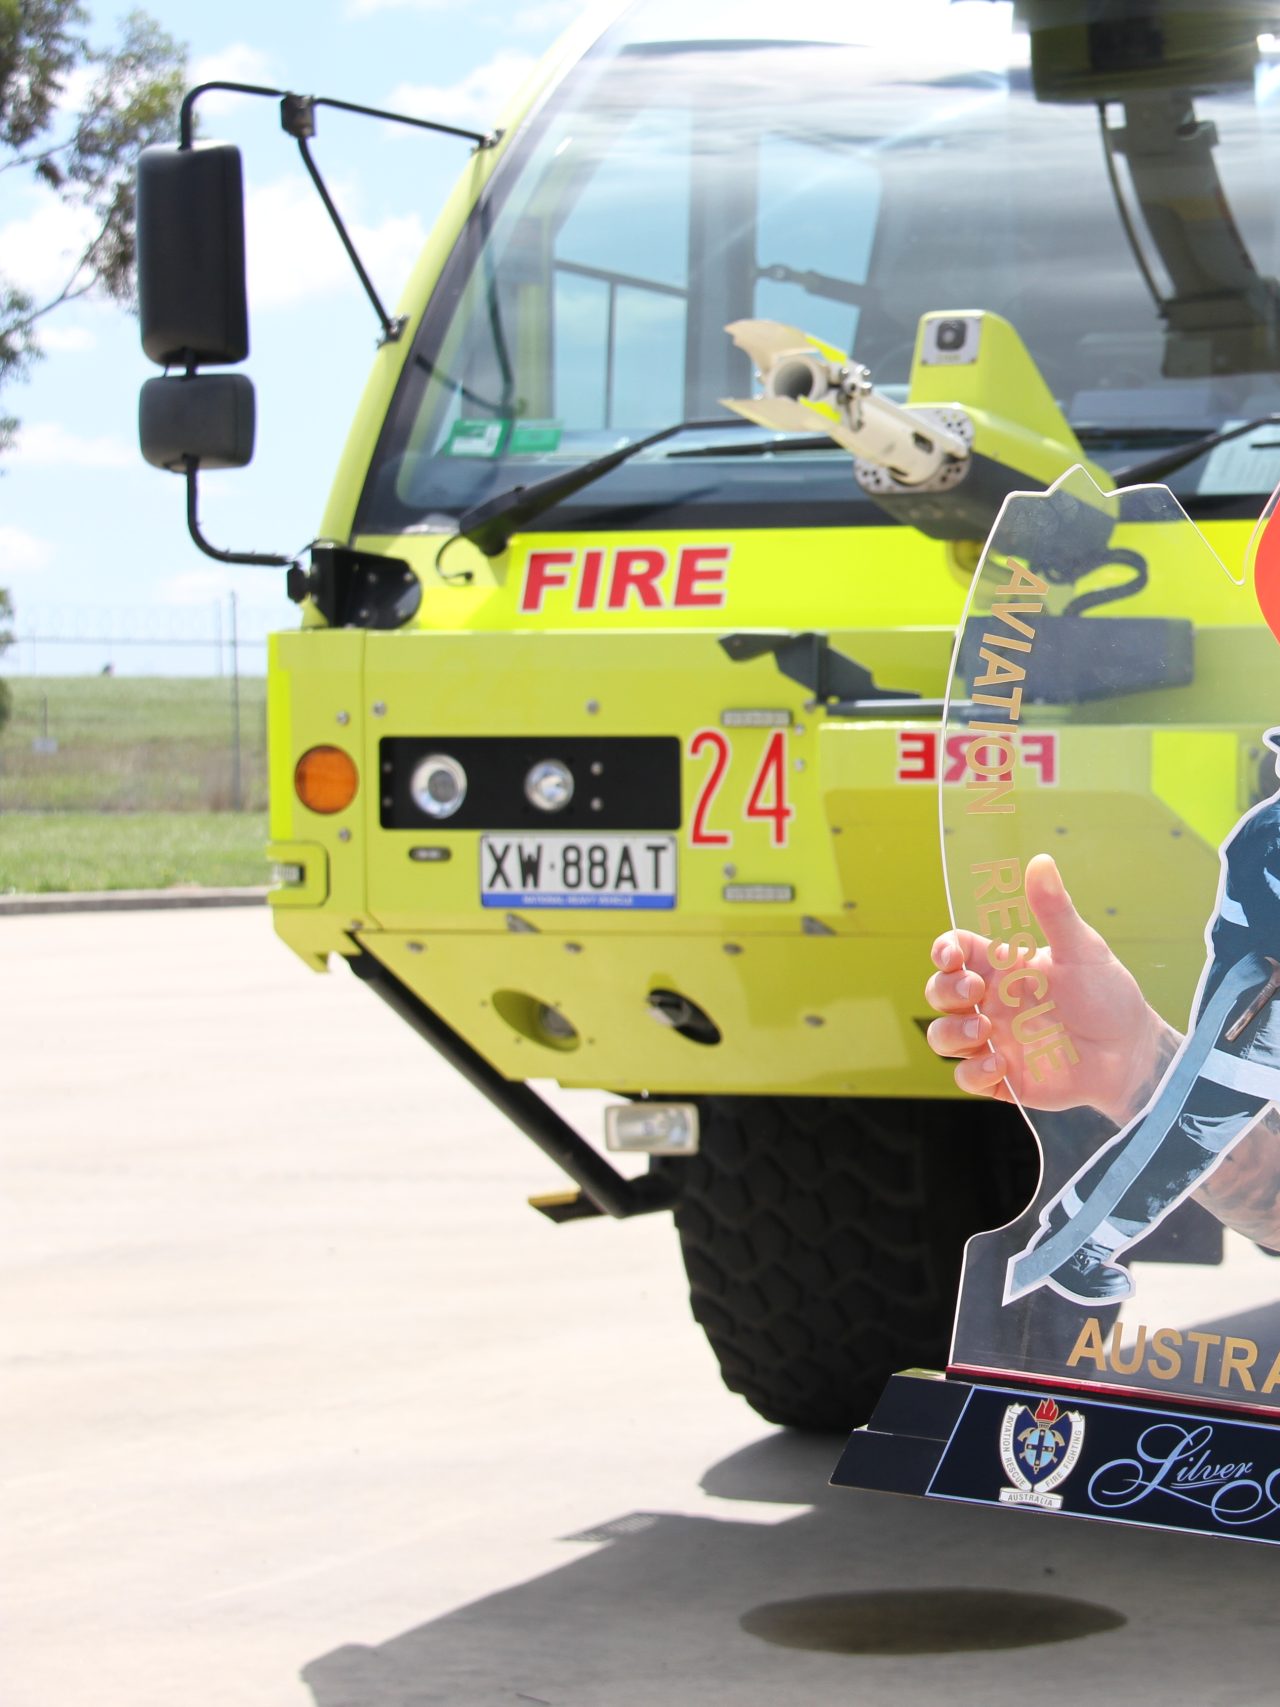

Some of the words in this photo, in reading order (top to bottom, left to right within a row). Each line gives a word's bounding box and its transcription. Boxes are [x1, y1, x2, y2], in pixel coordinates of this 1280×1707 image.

[519, 545, 732, 613] FIRE
[966, 556, 1050, 815] AVIATION
[688, 728, 794, 848] 24
[969, 857, 1080, 1082] RESCUE
[1002, 1416, 1014, 1453] AVIATION
[1044, 1471, 1065, 1488] FIRE
[1063, 1430, 1082, 1470] FIGHTING
[1087, 1423, 1256, 1512] Silver
[1004, 1457, 1026, 1488] RESCUE
[1007, 1493, 1054, 1507] AUSTRALIA
